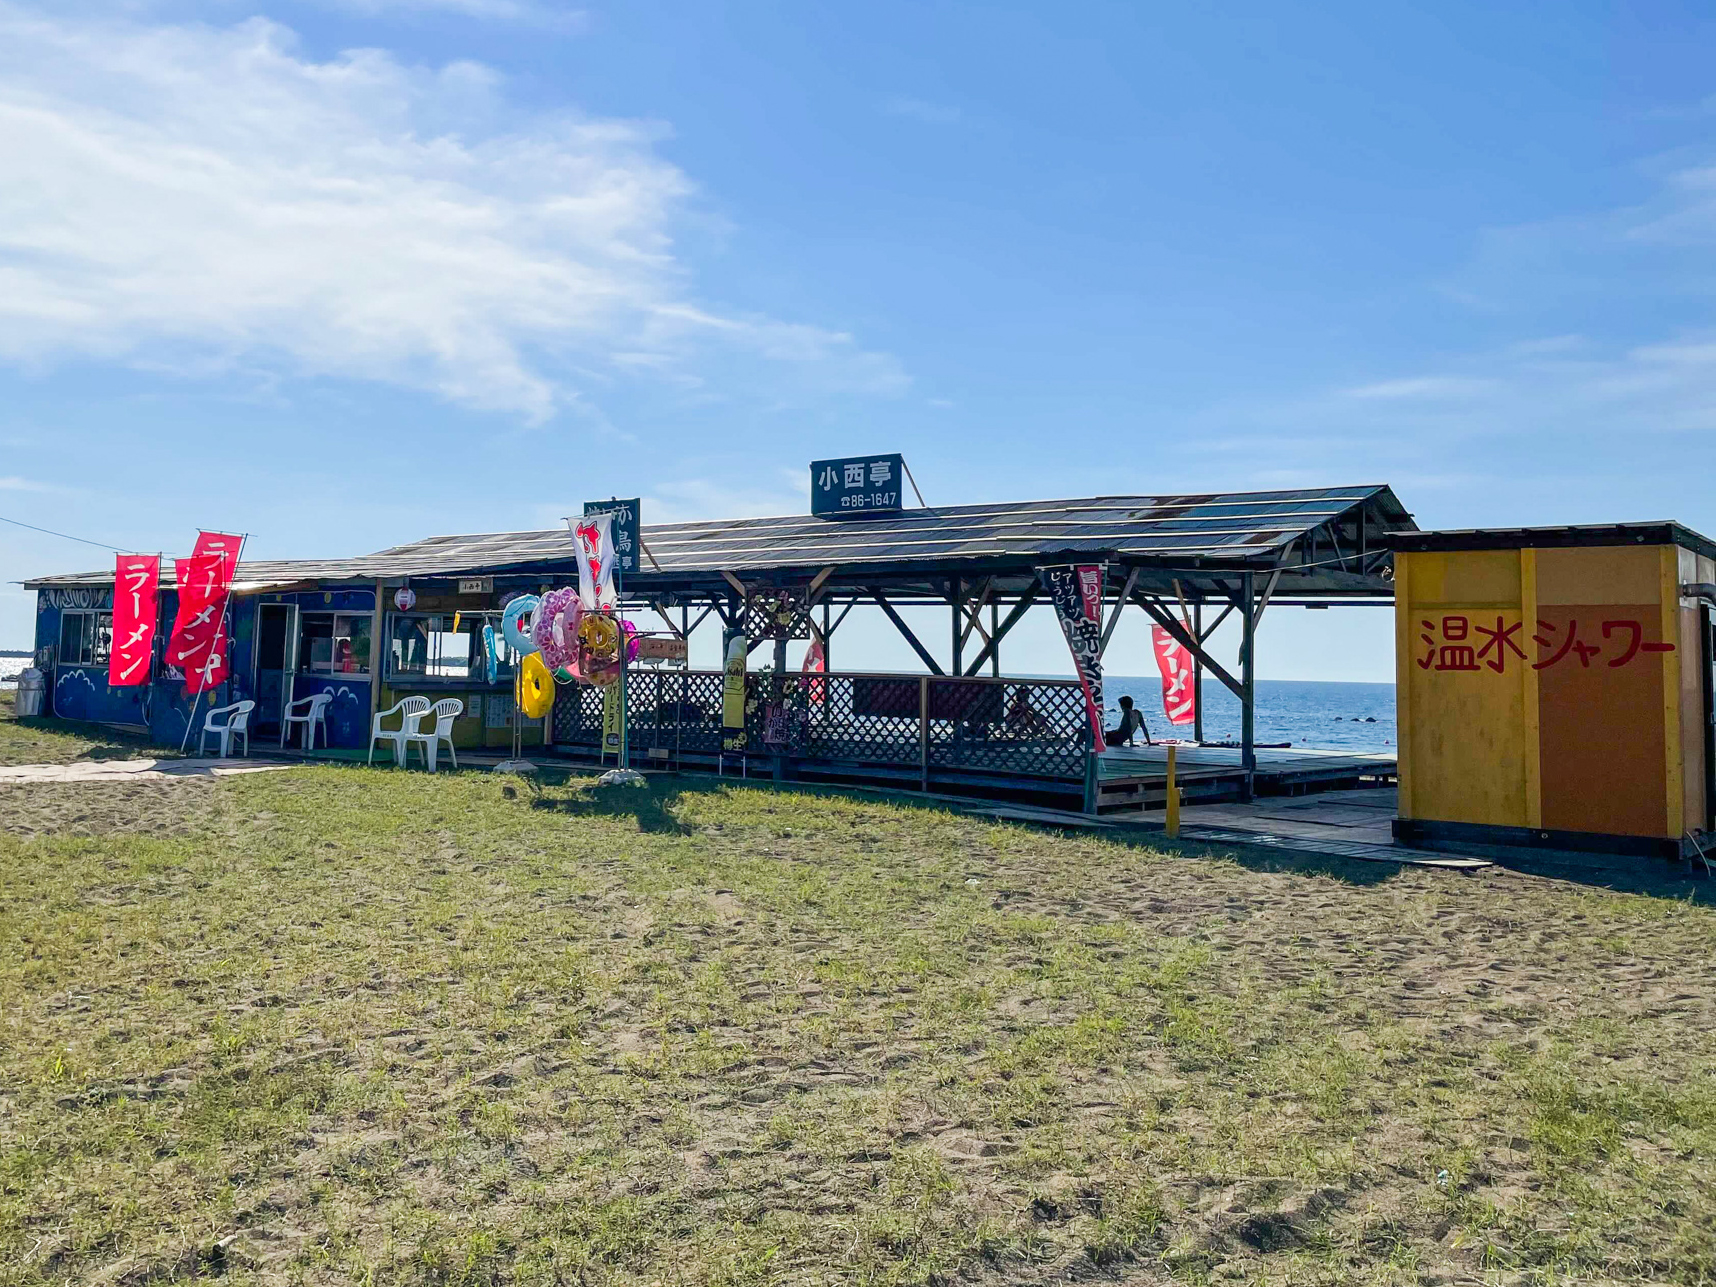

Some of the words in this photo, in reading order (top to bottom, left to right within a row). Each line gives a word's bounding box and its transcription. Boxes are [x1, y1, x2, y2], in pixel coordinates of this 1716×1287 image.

[818, 461, 892, 491] 小西亭
[120, 563, 150, 681] ラーメン
[177, 541, 229, 661] ラーメン
[1416, 615, 1676, 673] 温水シャワー
